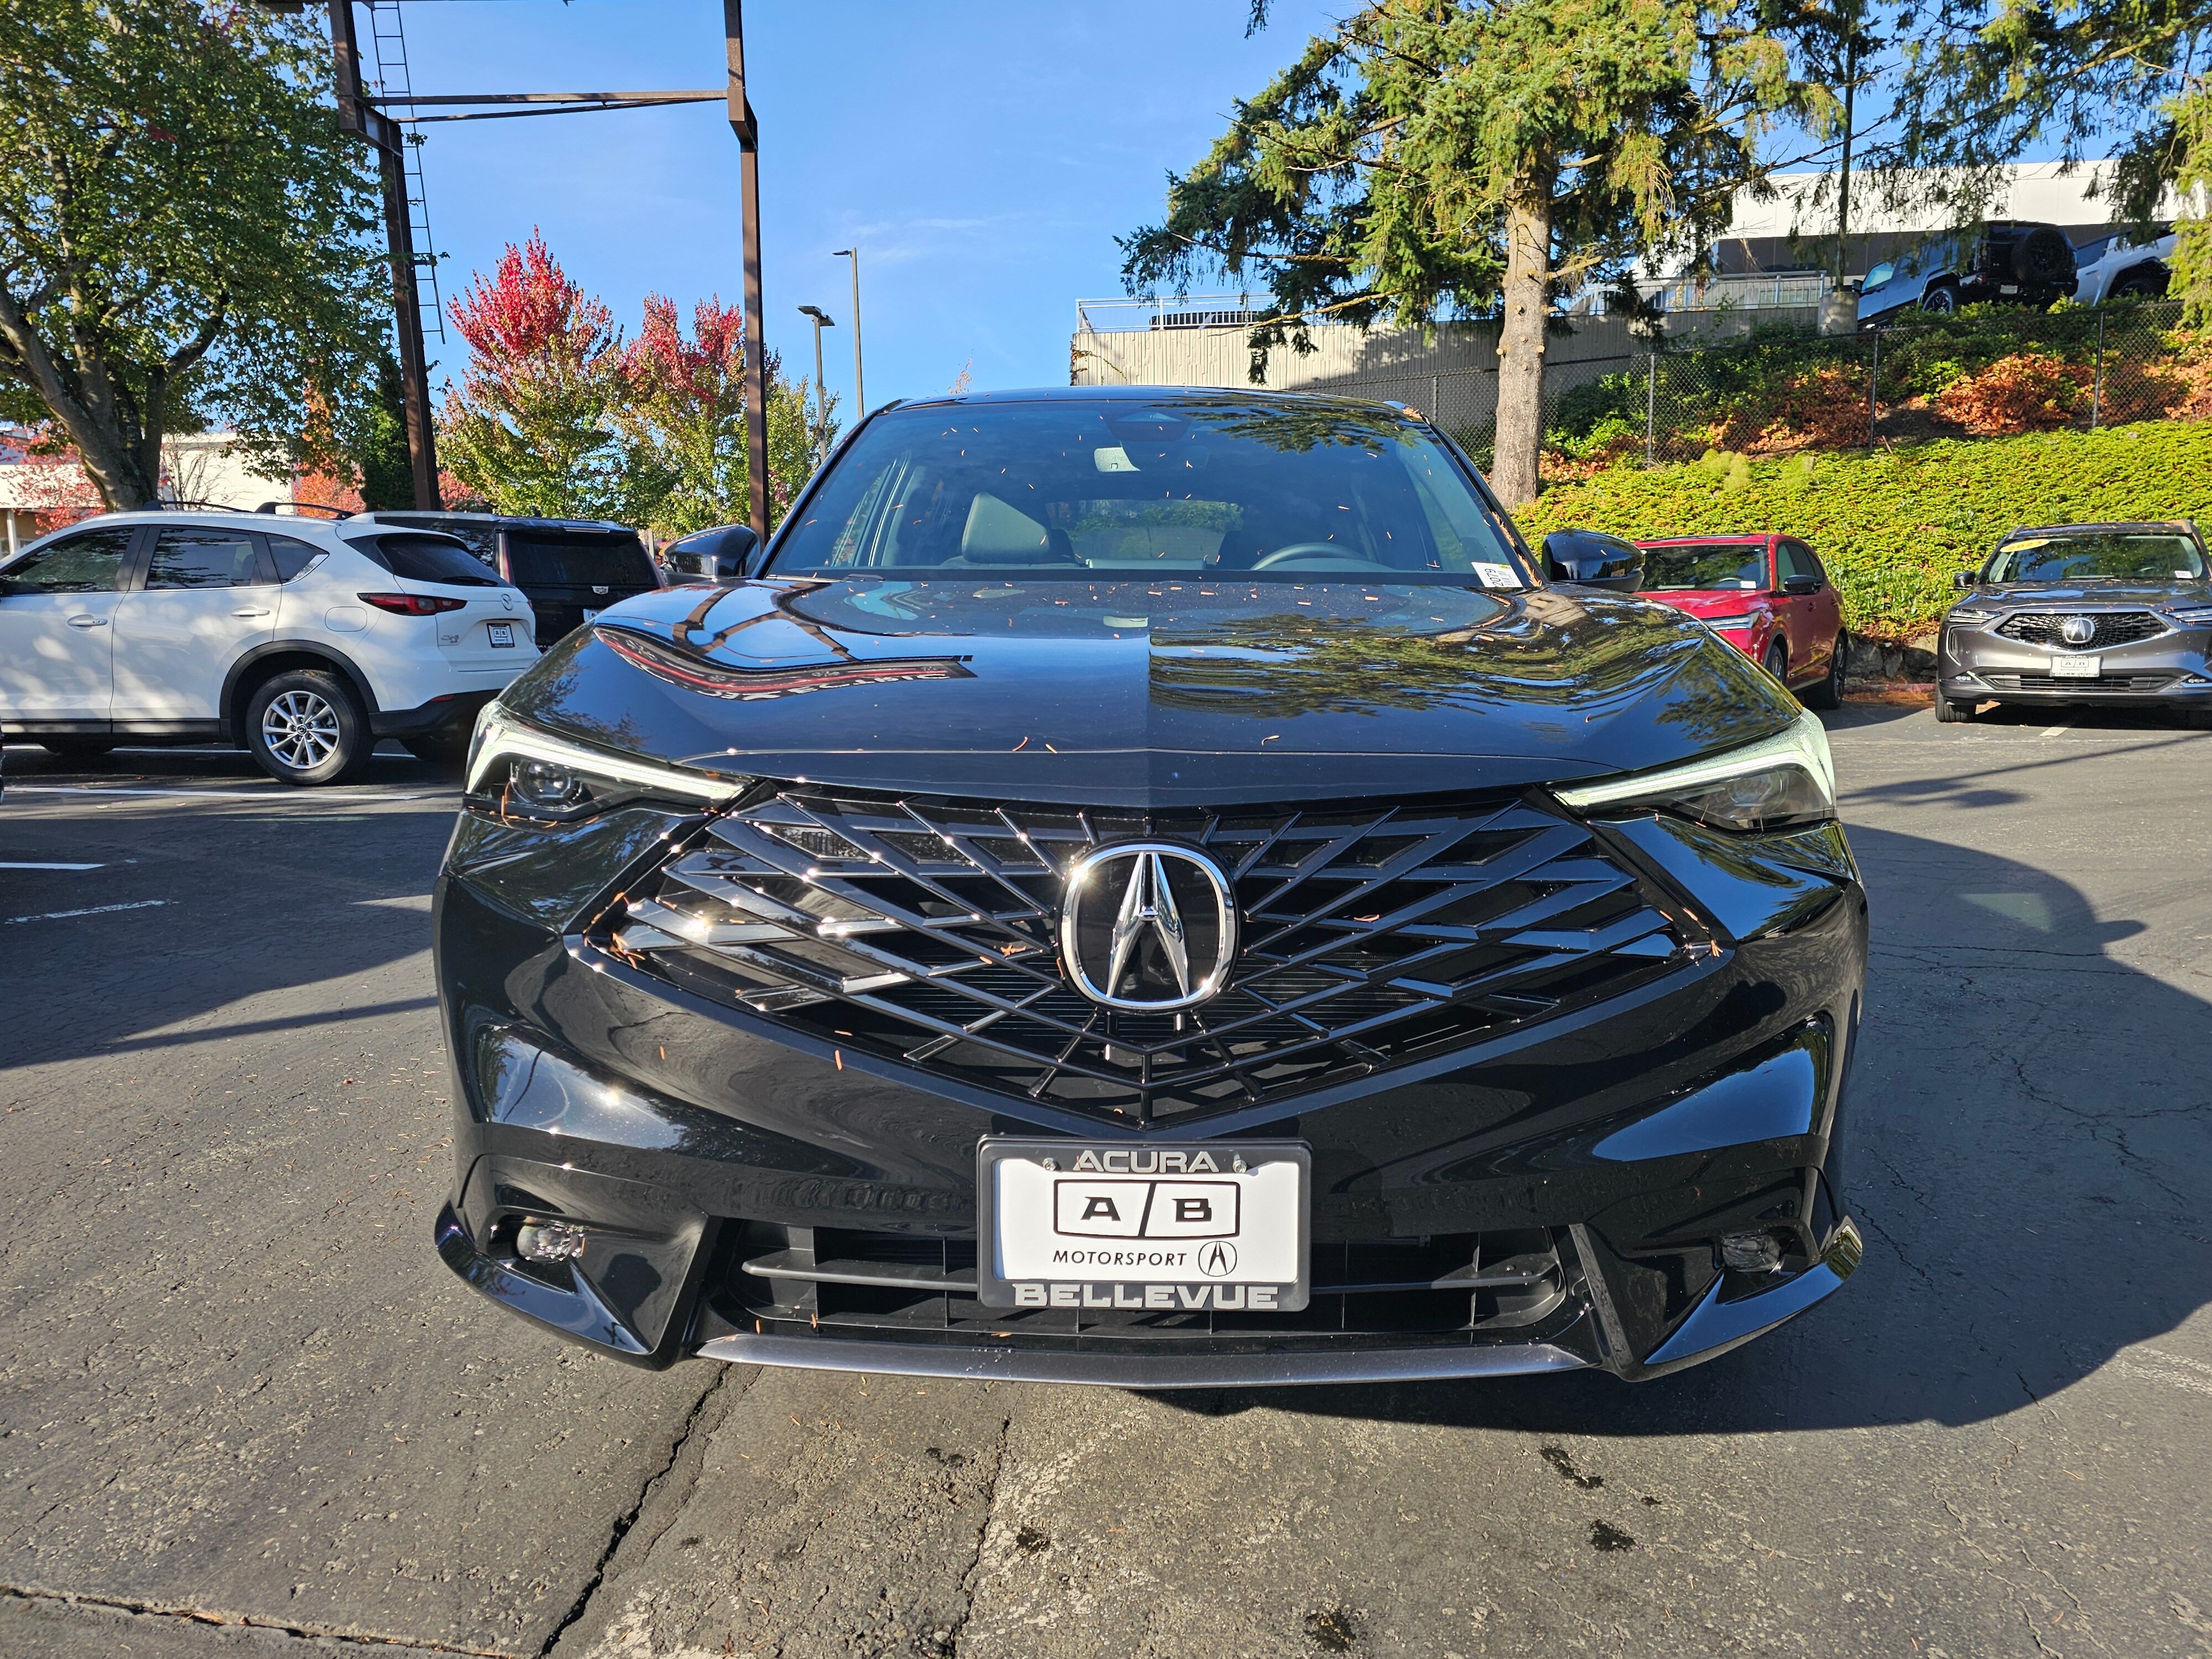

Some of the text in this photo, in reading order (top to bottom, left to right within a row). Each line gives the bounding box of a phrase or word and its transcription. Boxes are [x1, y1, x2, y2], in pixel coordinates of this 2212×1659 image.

[1072, 1150, 1220, 1173] ACURA
[1052, 1250, 1187, 1266] MOTORSPORT
[1012, 1282, 1279, 1310] BELLEVUE
